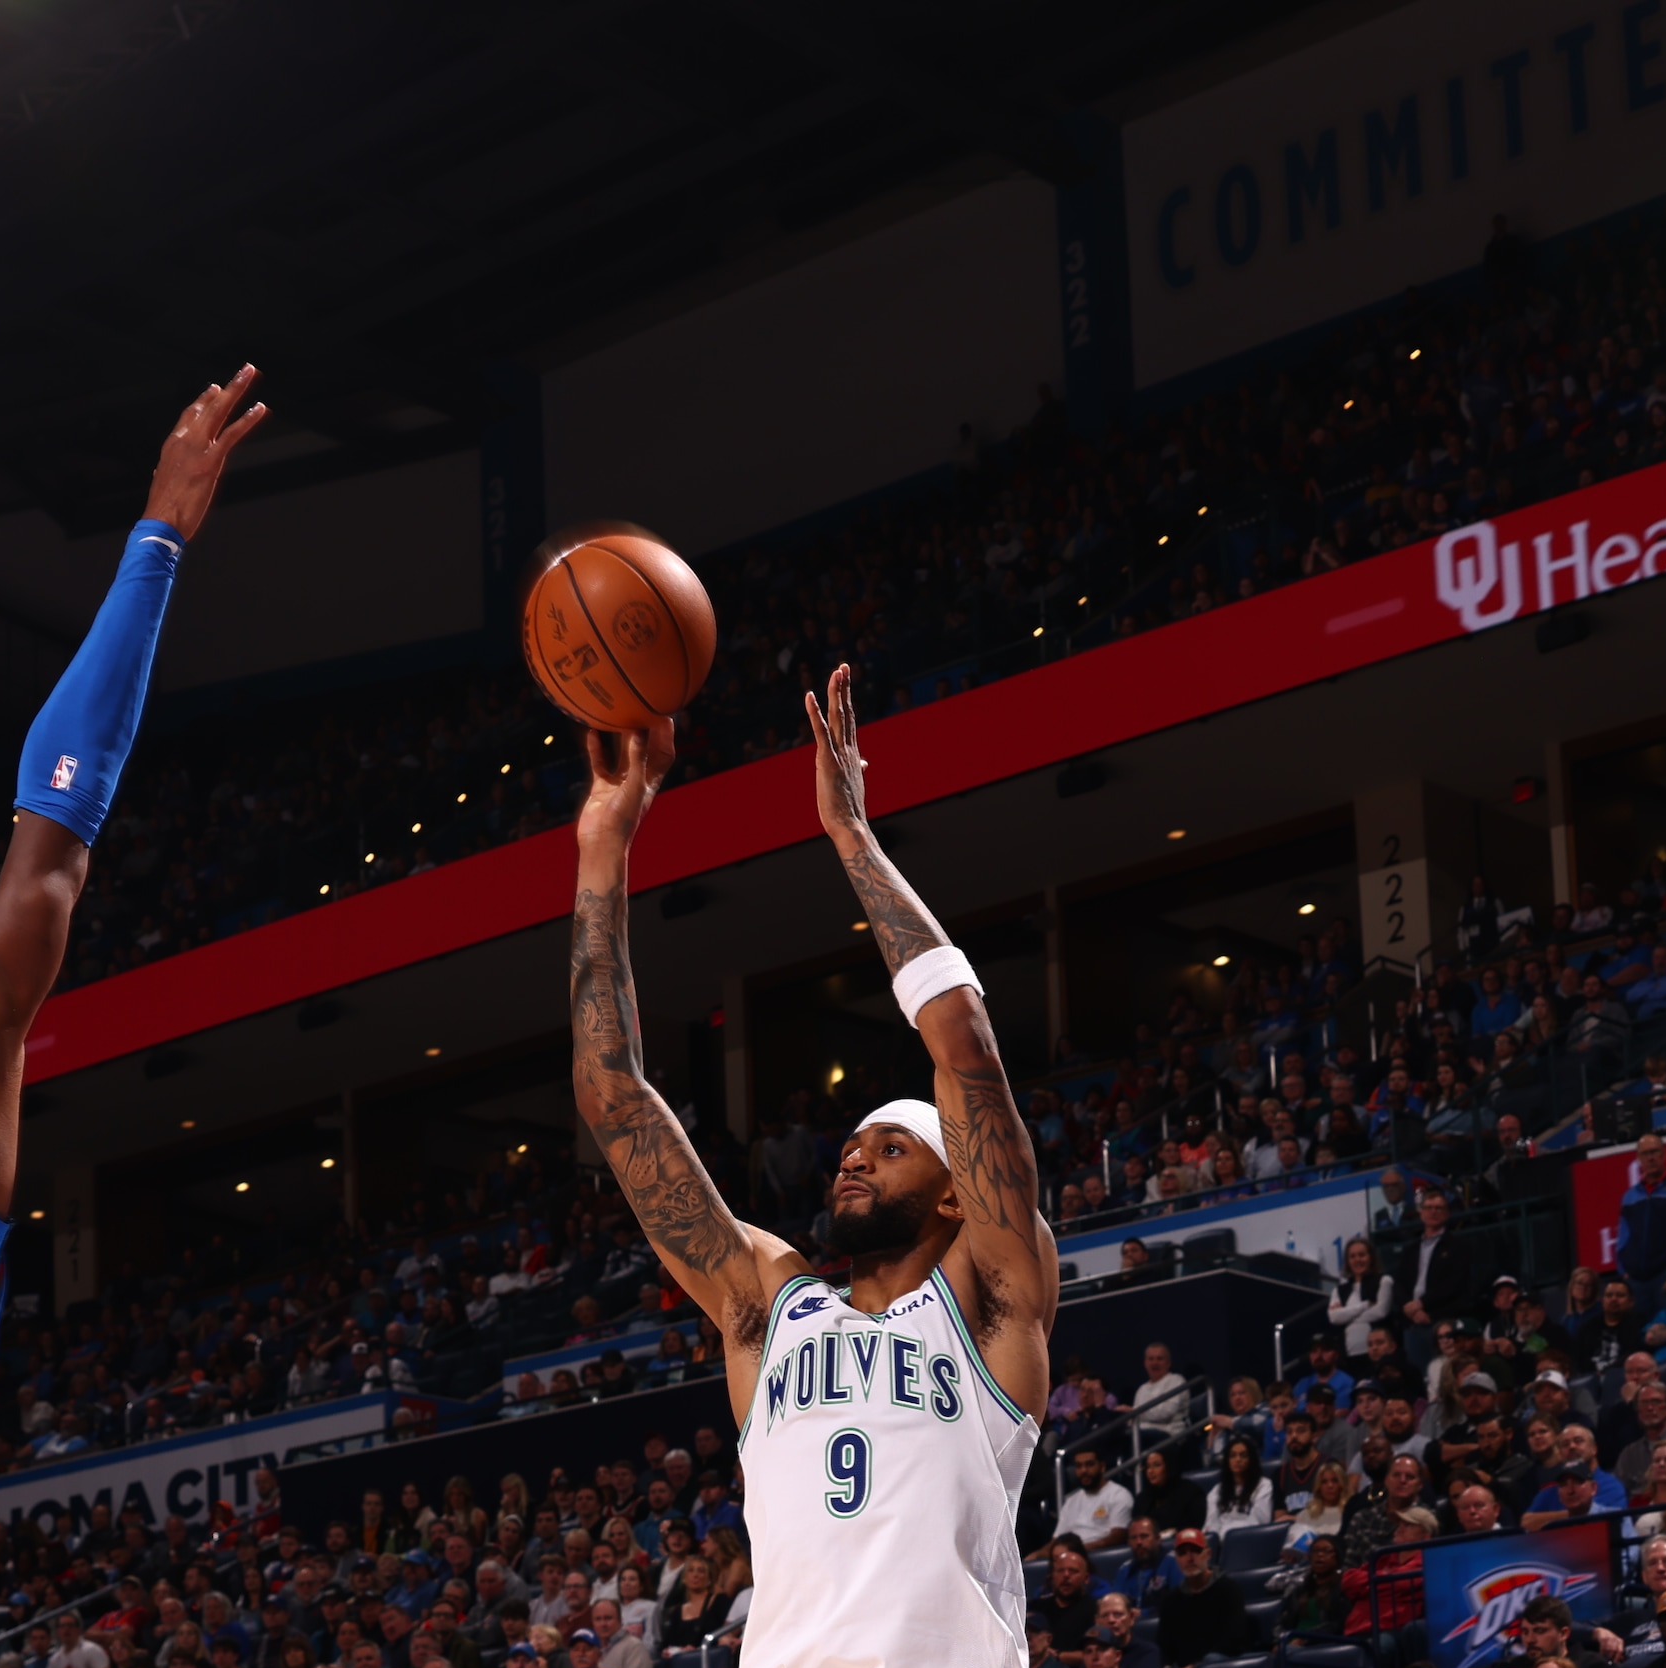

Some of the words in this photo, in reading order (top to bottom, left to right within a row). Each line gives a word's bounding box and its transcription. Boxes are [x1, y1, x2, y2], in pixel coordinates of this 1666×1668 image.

[1065, 239, 1092, 350] 322
[1383, 834, 1405, 944] 222
[765, 1330, 964, 1438] WOLVES
[825, 1427, 873, 1519] 9
